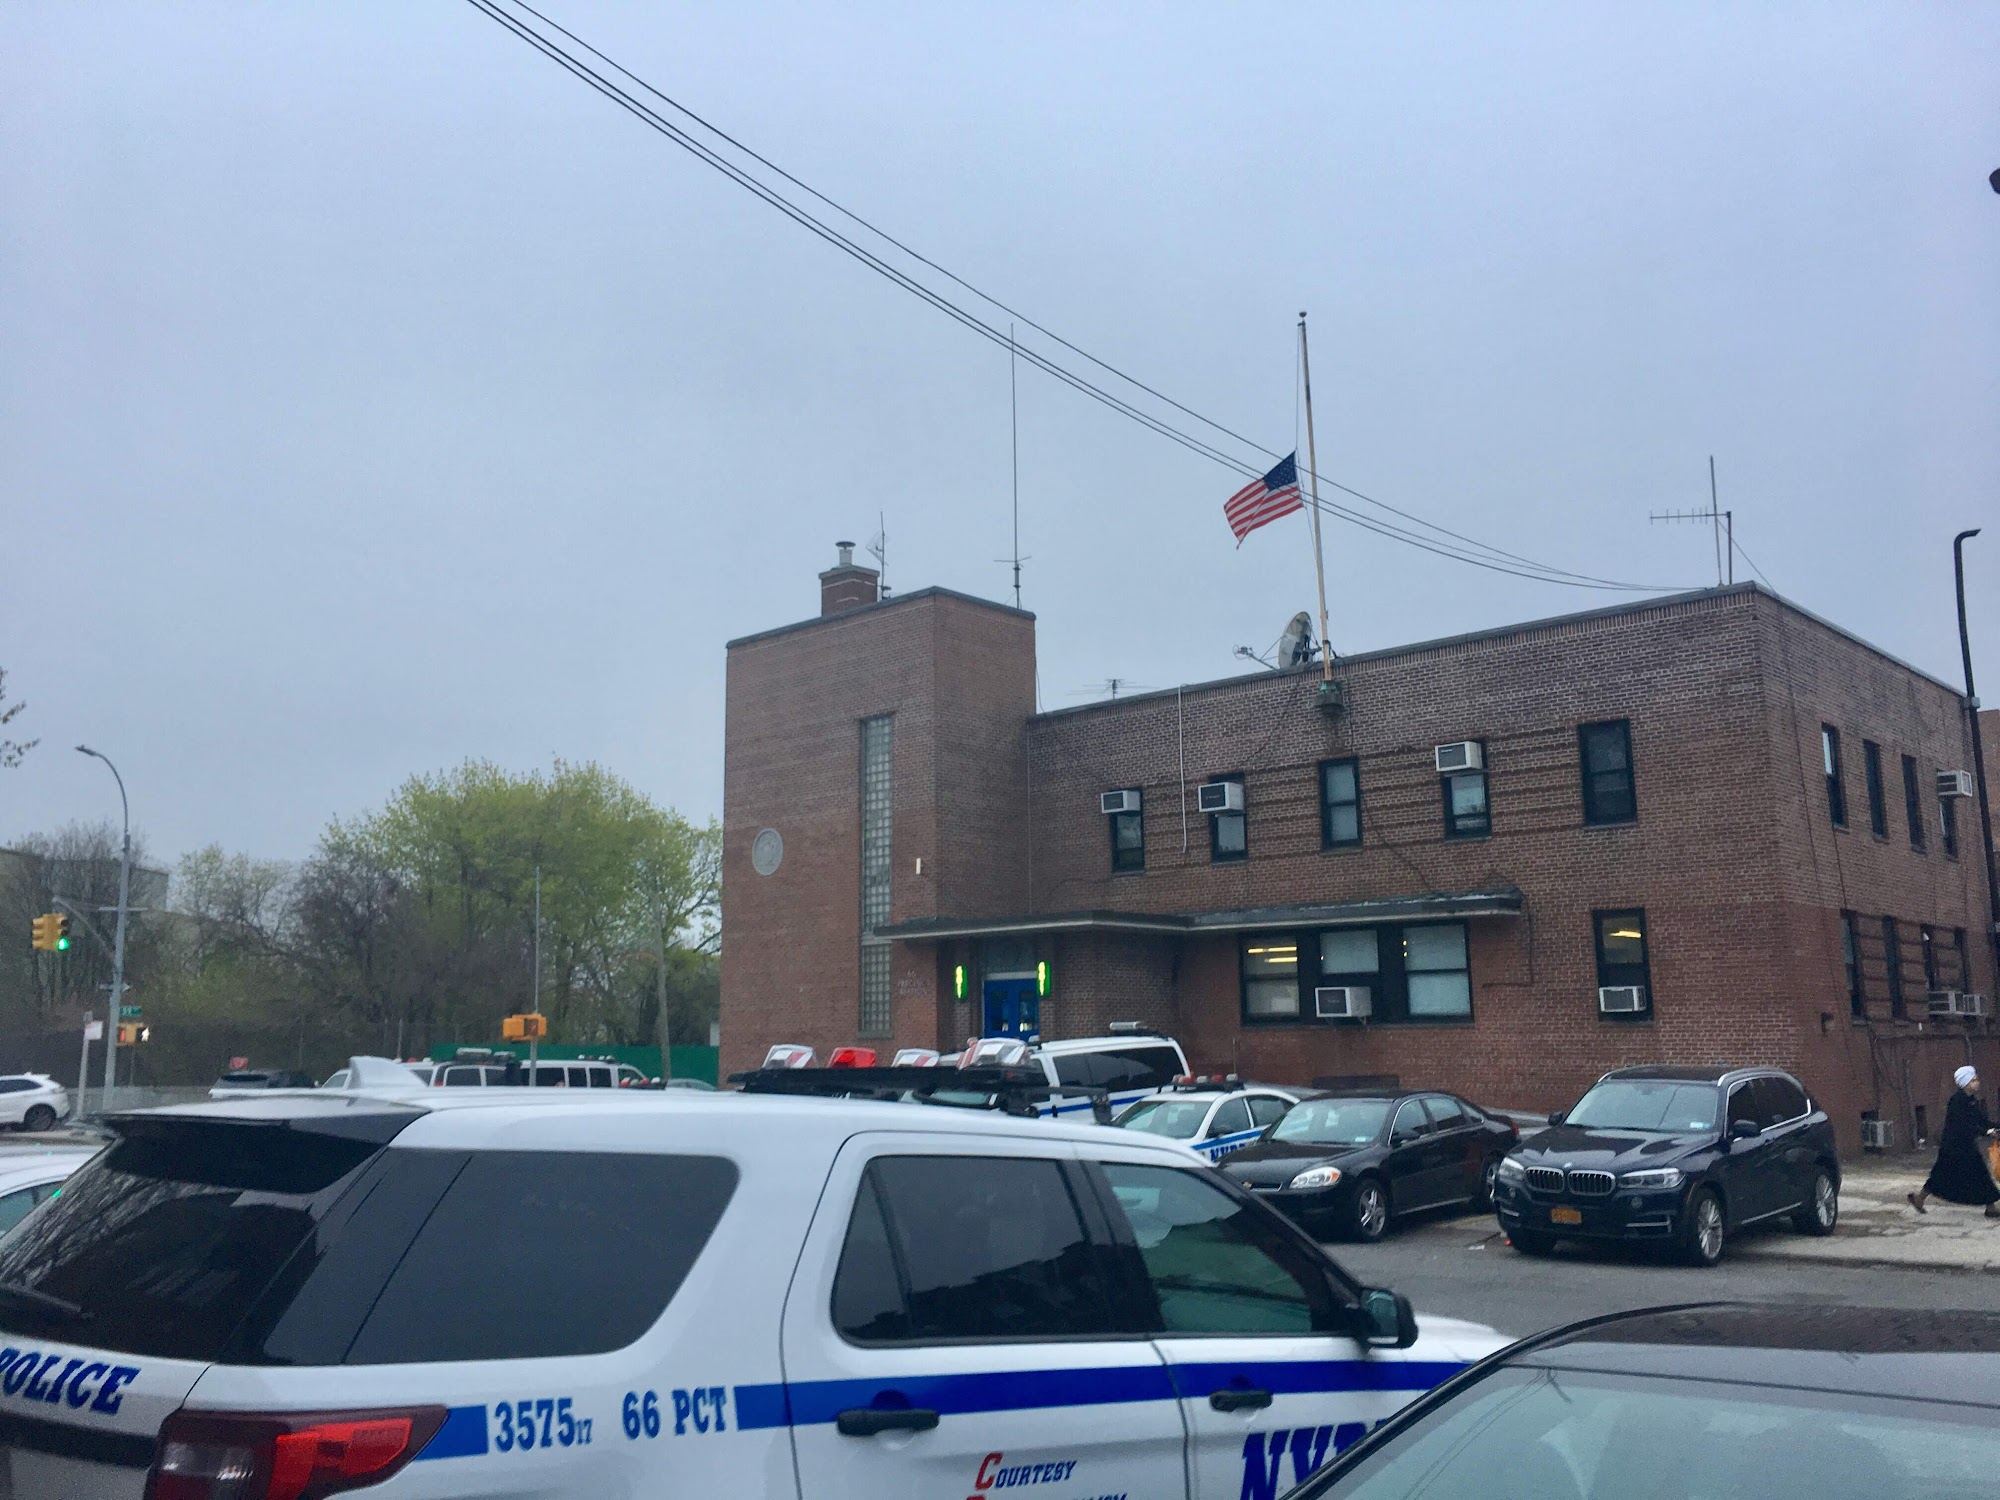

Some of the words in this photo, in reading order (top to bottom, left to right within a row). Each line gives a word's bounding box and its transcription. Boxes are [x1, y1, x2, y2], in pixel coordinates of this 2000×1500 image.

[622, 1390, 661, 1440] 66
[672, 1385, 727, 1436] PCT
[975, 1452, 1078, 1491] COURTESY
[1240, 1418, 1389, 1500] NY
